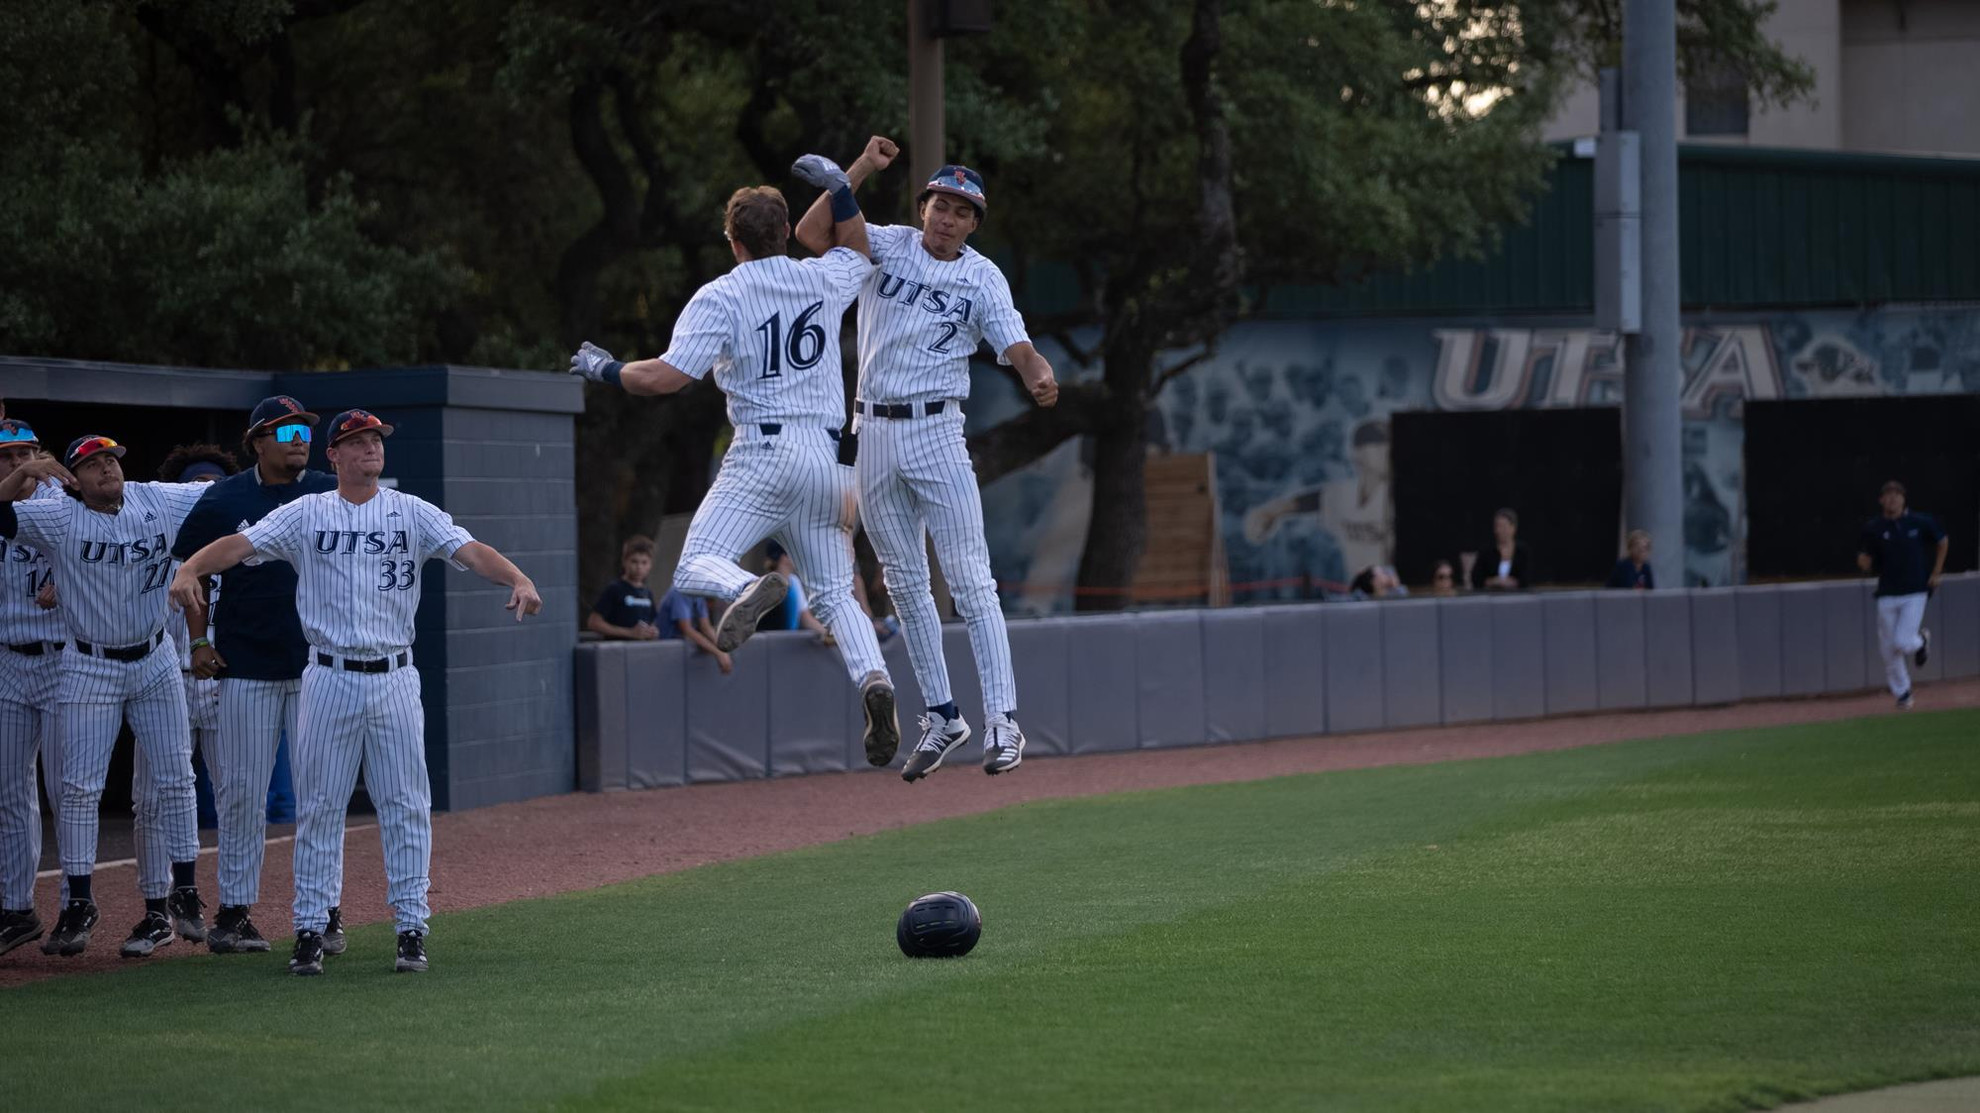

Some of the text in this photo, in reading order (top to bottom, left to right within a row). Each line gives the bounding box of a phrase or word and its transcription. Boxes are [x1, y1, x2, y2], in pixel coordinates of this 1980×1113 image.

[877, 272, 973, 325] UTSA
[755, 300, 826, 379] 16
[927, 321, 958, 354] 2
[1430, 323, 1783, 412] UTA
[80, 533, 168, 566] UTSA
[315, 530, 409, 555] UTSA
[140, 557, 172, 594] 27
[377, 560, 416, 591] 33
